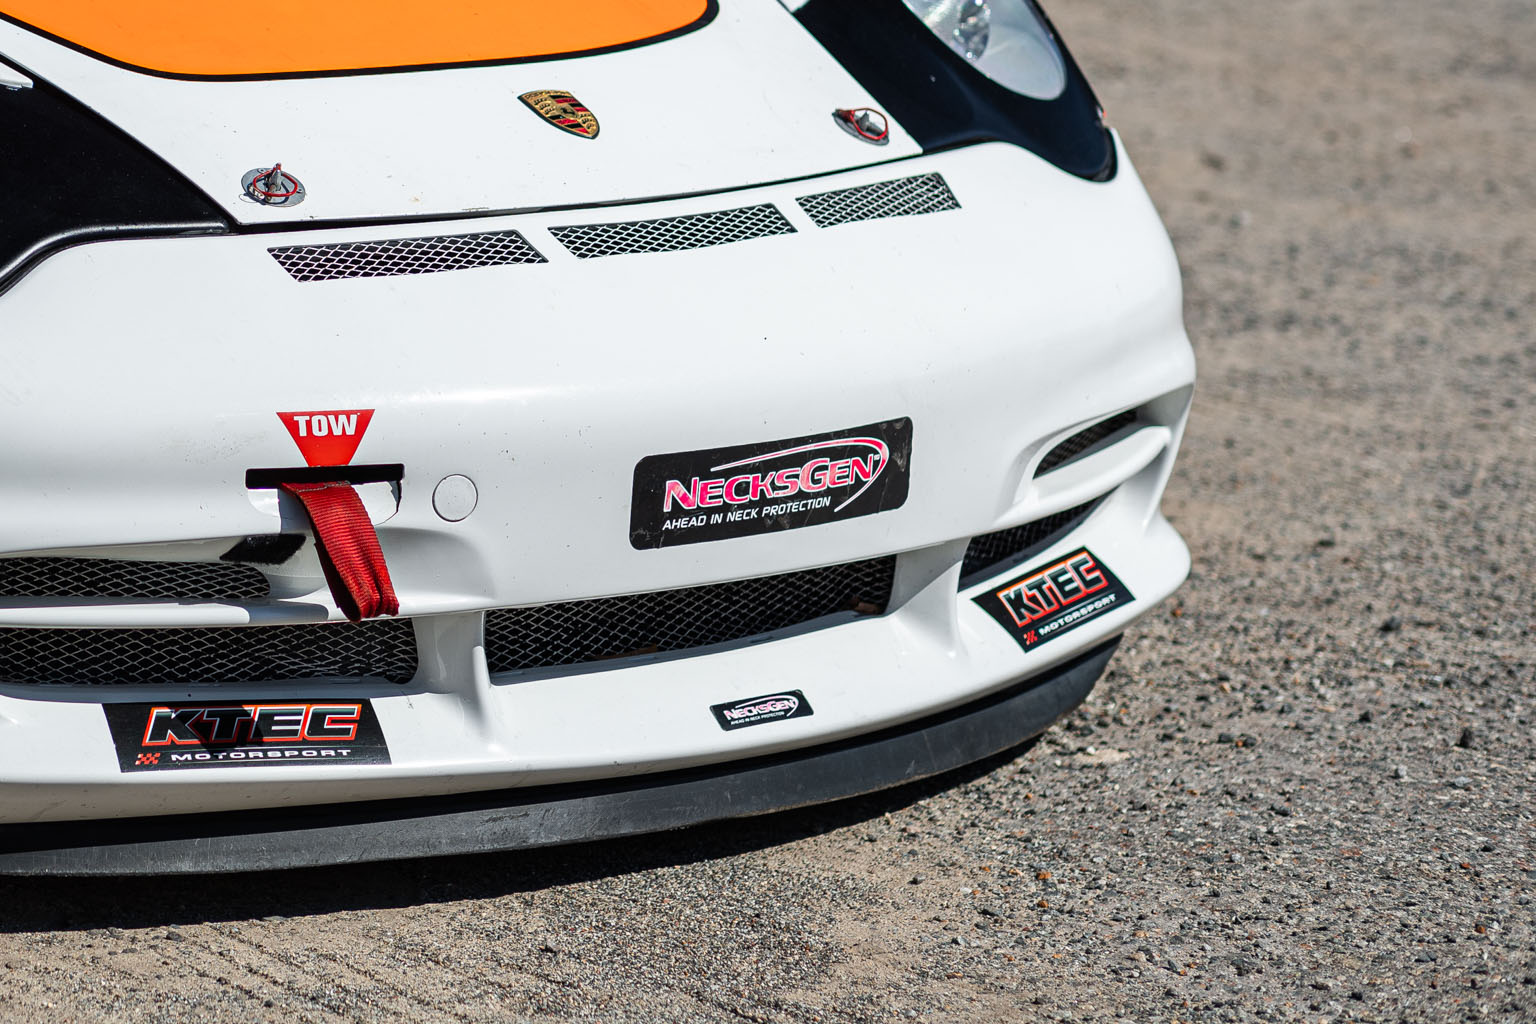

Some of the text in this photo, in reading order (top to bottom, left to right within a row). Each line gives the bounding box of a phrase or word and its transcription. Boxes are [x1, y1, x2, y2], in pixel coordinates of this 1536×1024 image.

[293, 414, 358, 437] TOW
[662, 496, 832, 531] AHEAD IN NECK PROTECTION
[996, 551, 1109, 628] KTEC
[1038, 593, 1117, 637] MOTORSPORT
[141, 703, 362, 747] KTEC
[171, 749, 352, 761] MOTORSPORT
